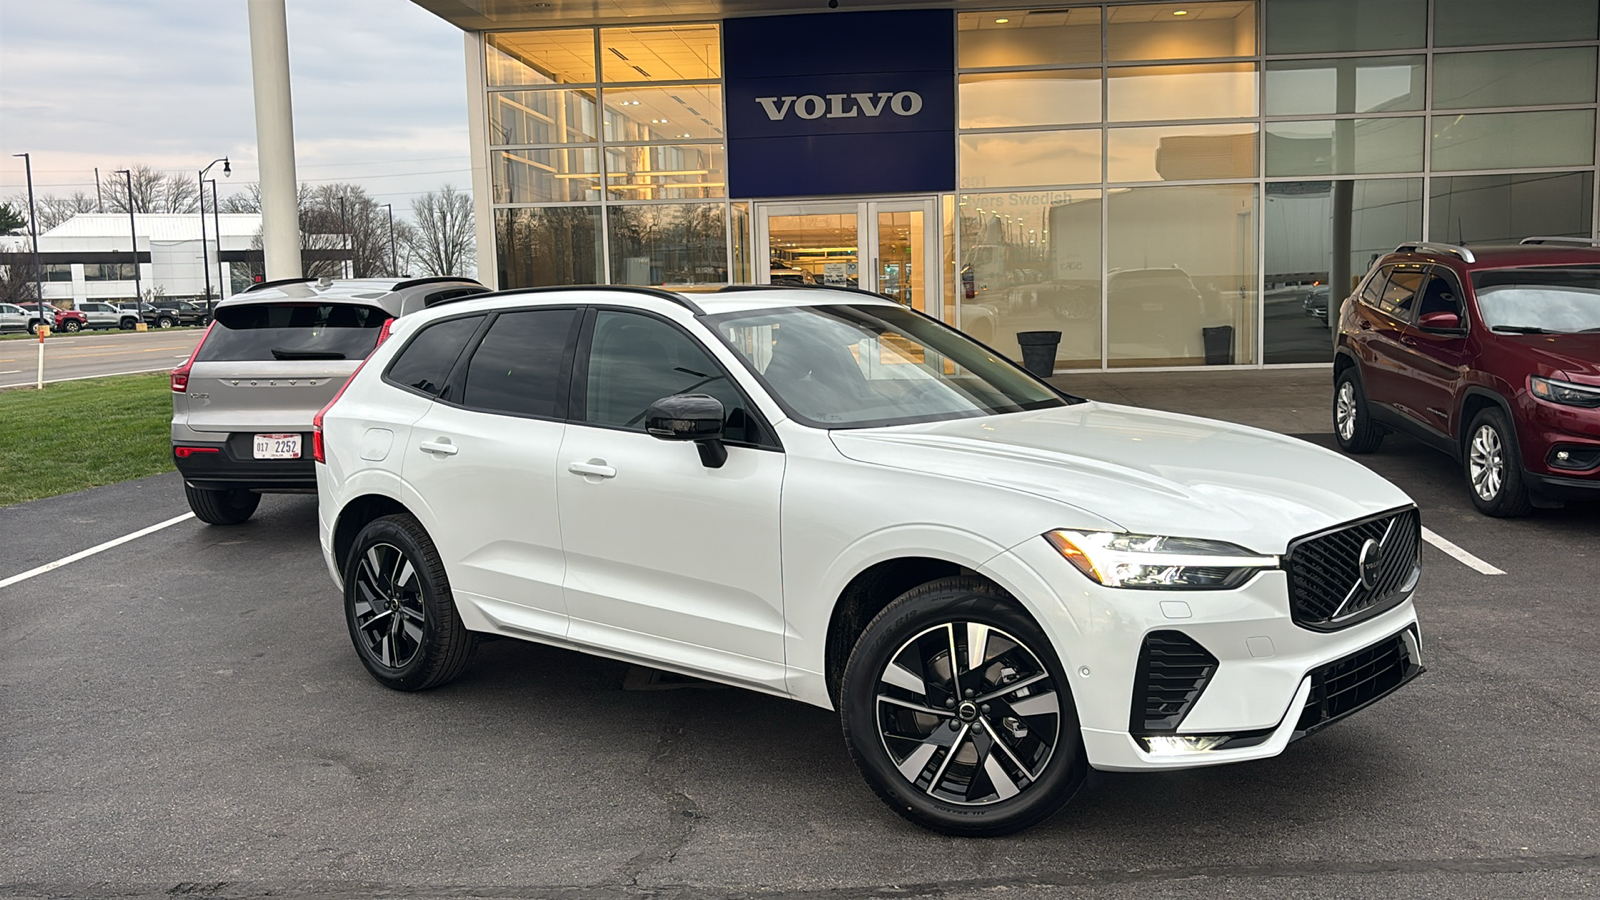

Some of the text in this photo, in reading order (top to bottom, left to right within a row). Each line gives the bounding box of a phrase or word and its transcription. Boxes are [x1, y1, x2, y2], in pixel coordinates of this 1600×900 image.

[755, 91, 923, 121] VOLVO
[1008, 192, 1073, 206] Swedish
[256, 440, 297, 453] 017 2252
